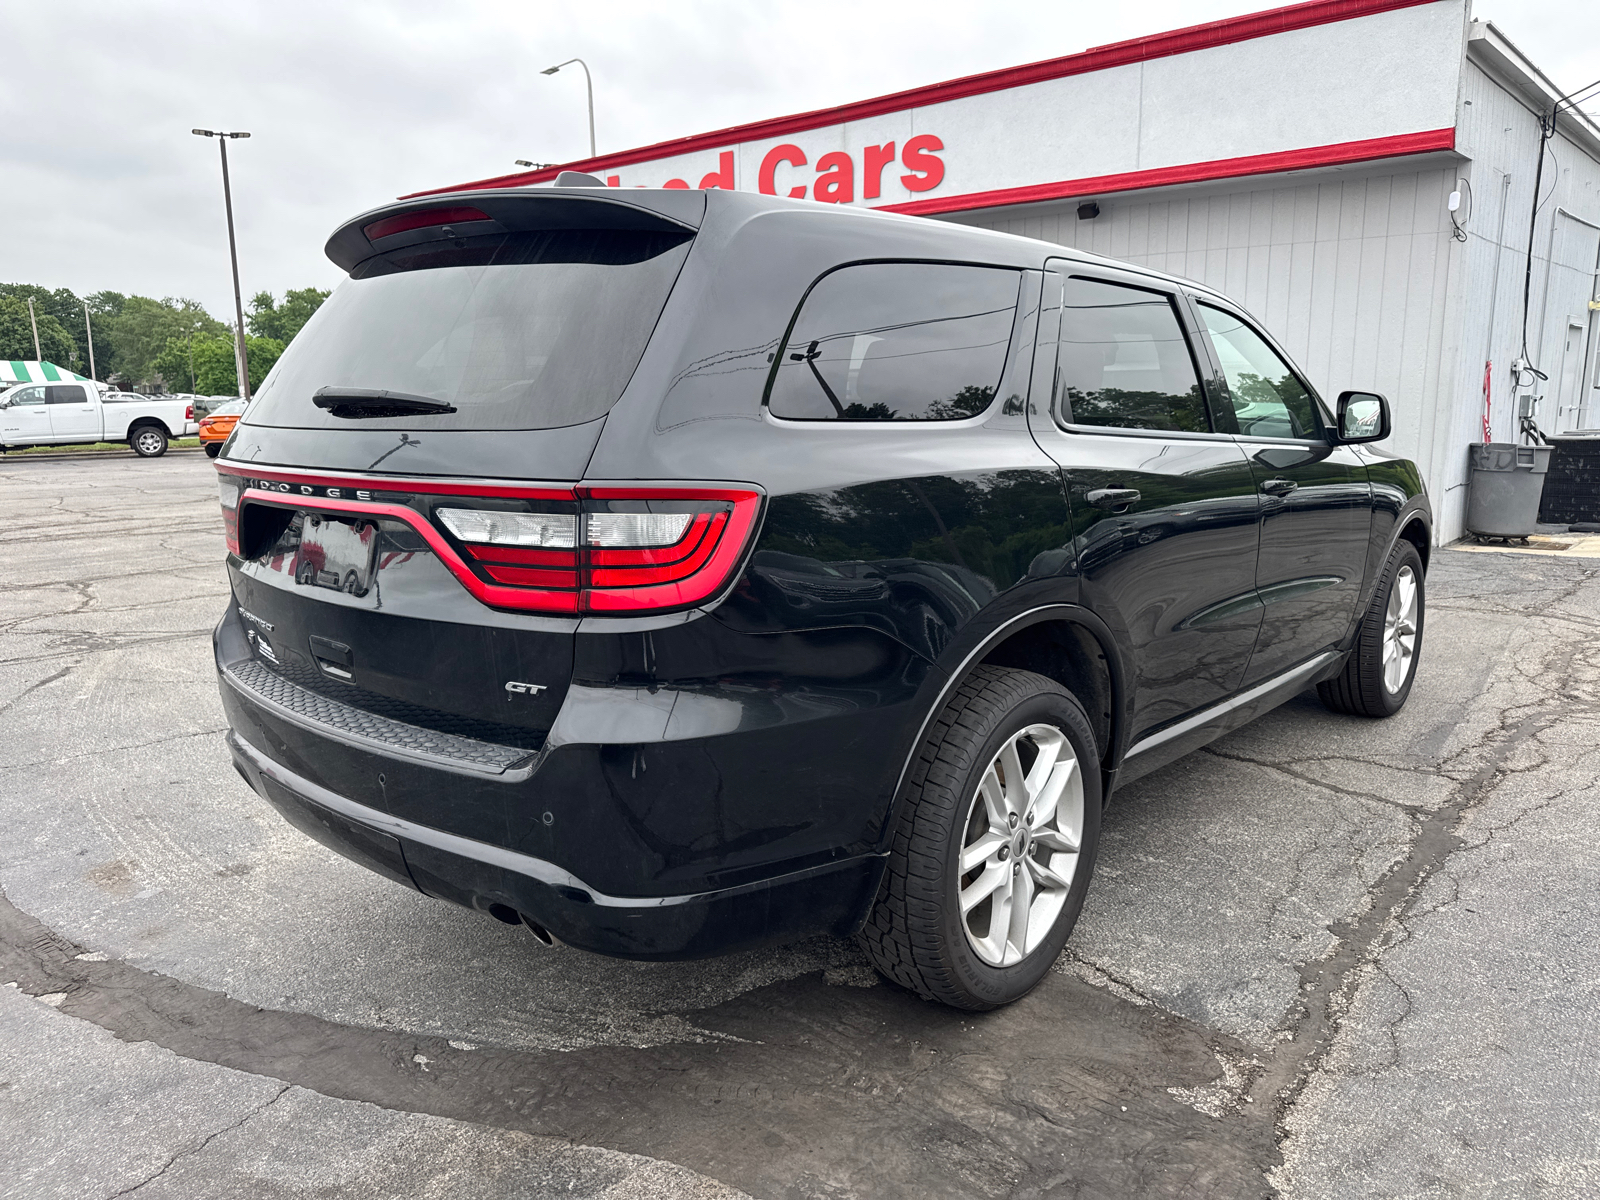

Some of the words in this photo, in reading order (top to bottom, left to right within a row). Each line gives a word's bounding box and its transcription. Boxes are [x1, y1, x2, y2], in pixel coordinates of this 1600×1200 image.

[758, 134, 945, 204] Cars
[260, 480, 371, 500] DODGE
[505, 681, 548, 695] GT
